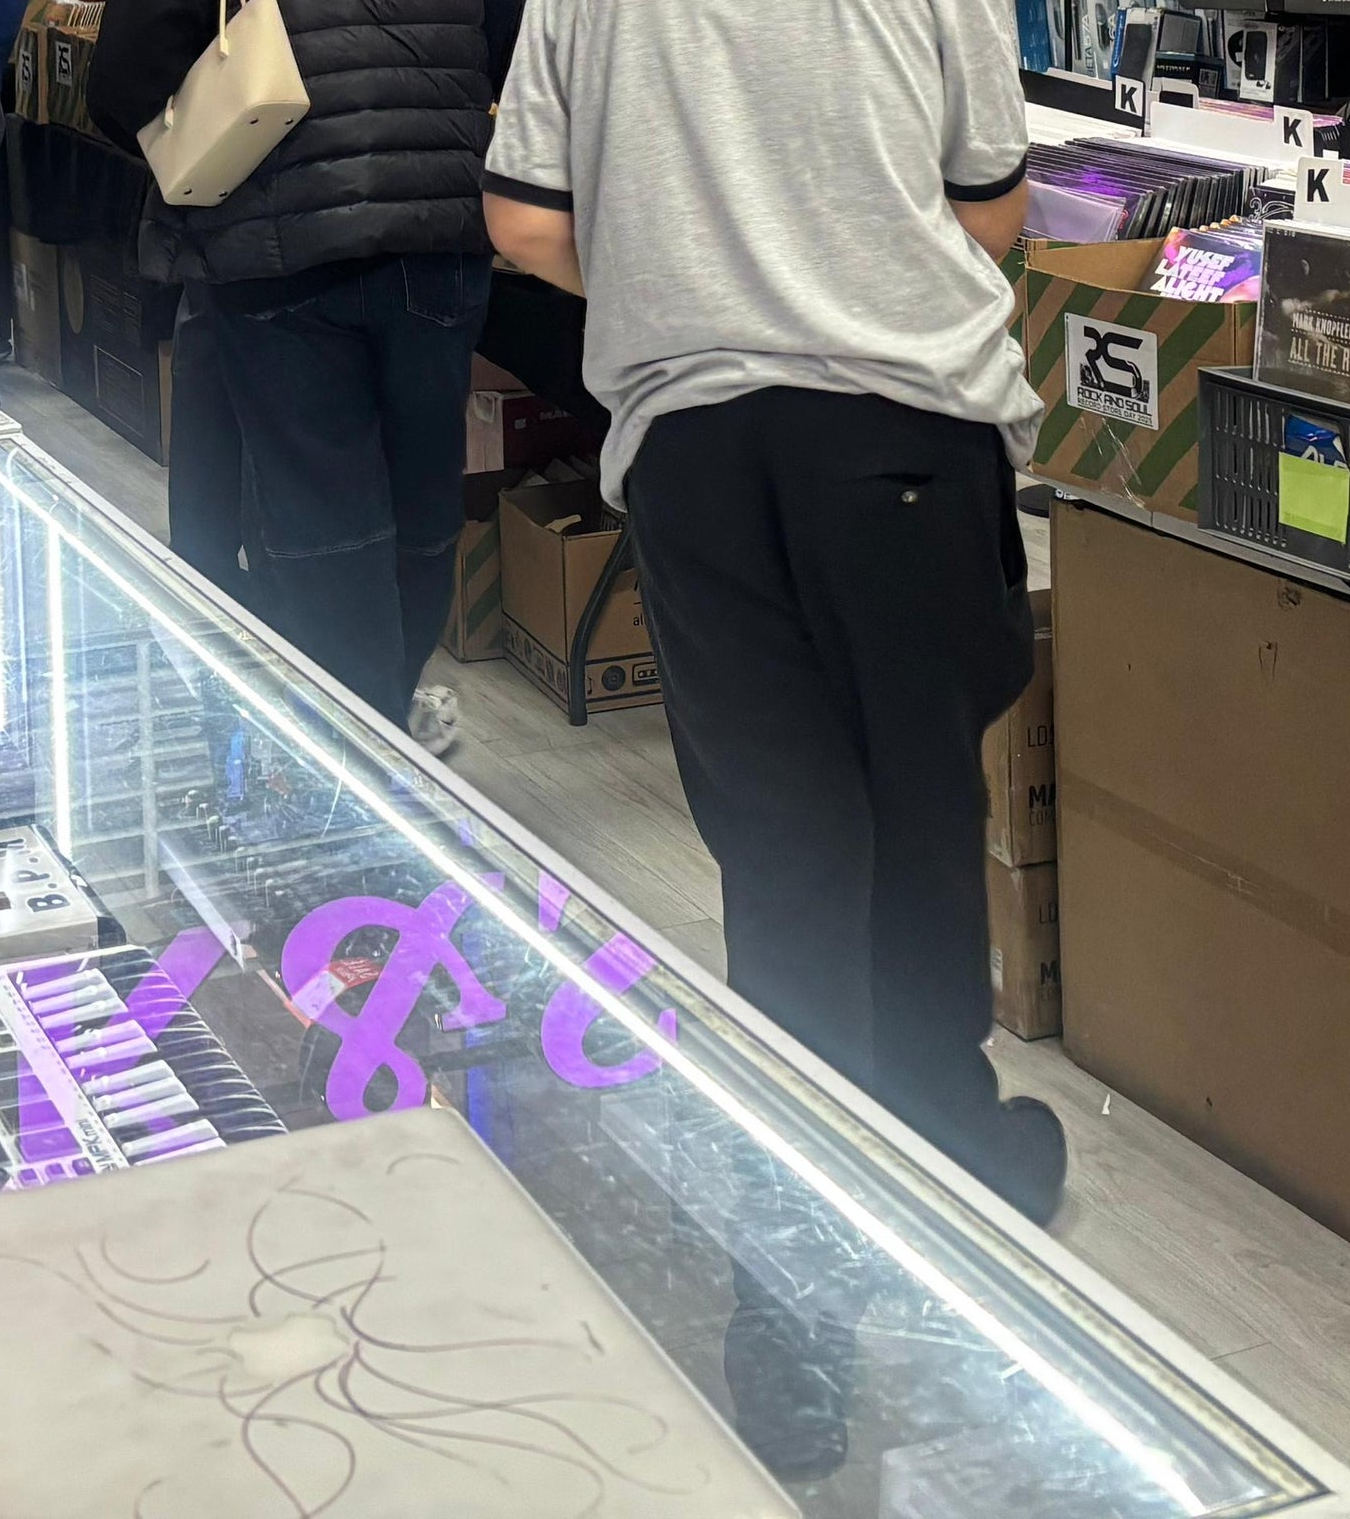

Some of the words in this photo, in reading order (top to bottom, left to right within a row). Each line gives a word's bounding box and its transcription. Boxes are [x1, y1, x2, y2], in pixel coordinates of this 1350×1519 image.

[1120, 83, 1137, 112] K
[1282, 117, 1302, 147] K
[1306, 167, 1330, 204] K
[1154, 257, 1227, 285] LATEEF
[1177, 246, 1235, 271] YUSEF
[1293, 312, 1314, 331] MARK
[1290, 337, 1310, 362] ALL
[1316, 342, 1337, 369] THE
[1077, 387, 1102, 401] ROCK
[1104, 394, 1124, 408] AND
[1126, 401, 1152, 416] SOUL
[1077, 398, 1102, 409] RECORD
[1103, 405, 1123, 416] STORE
